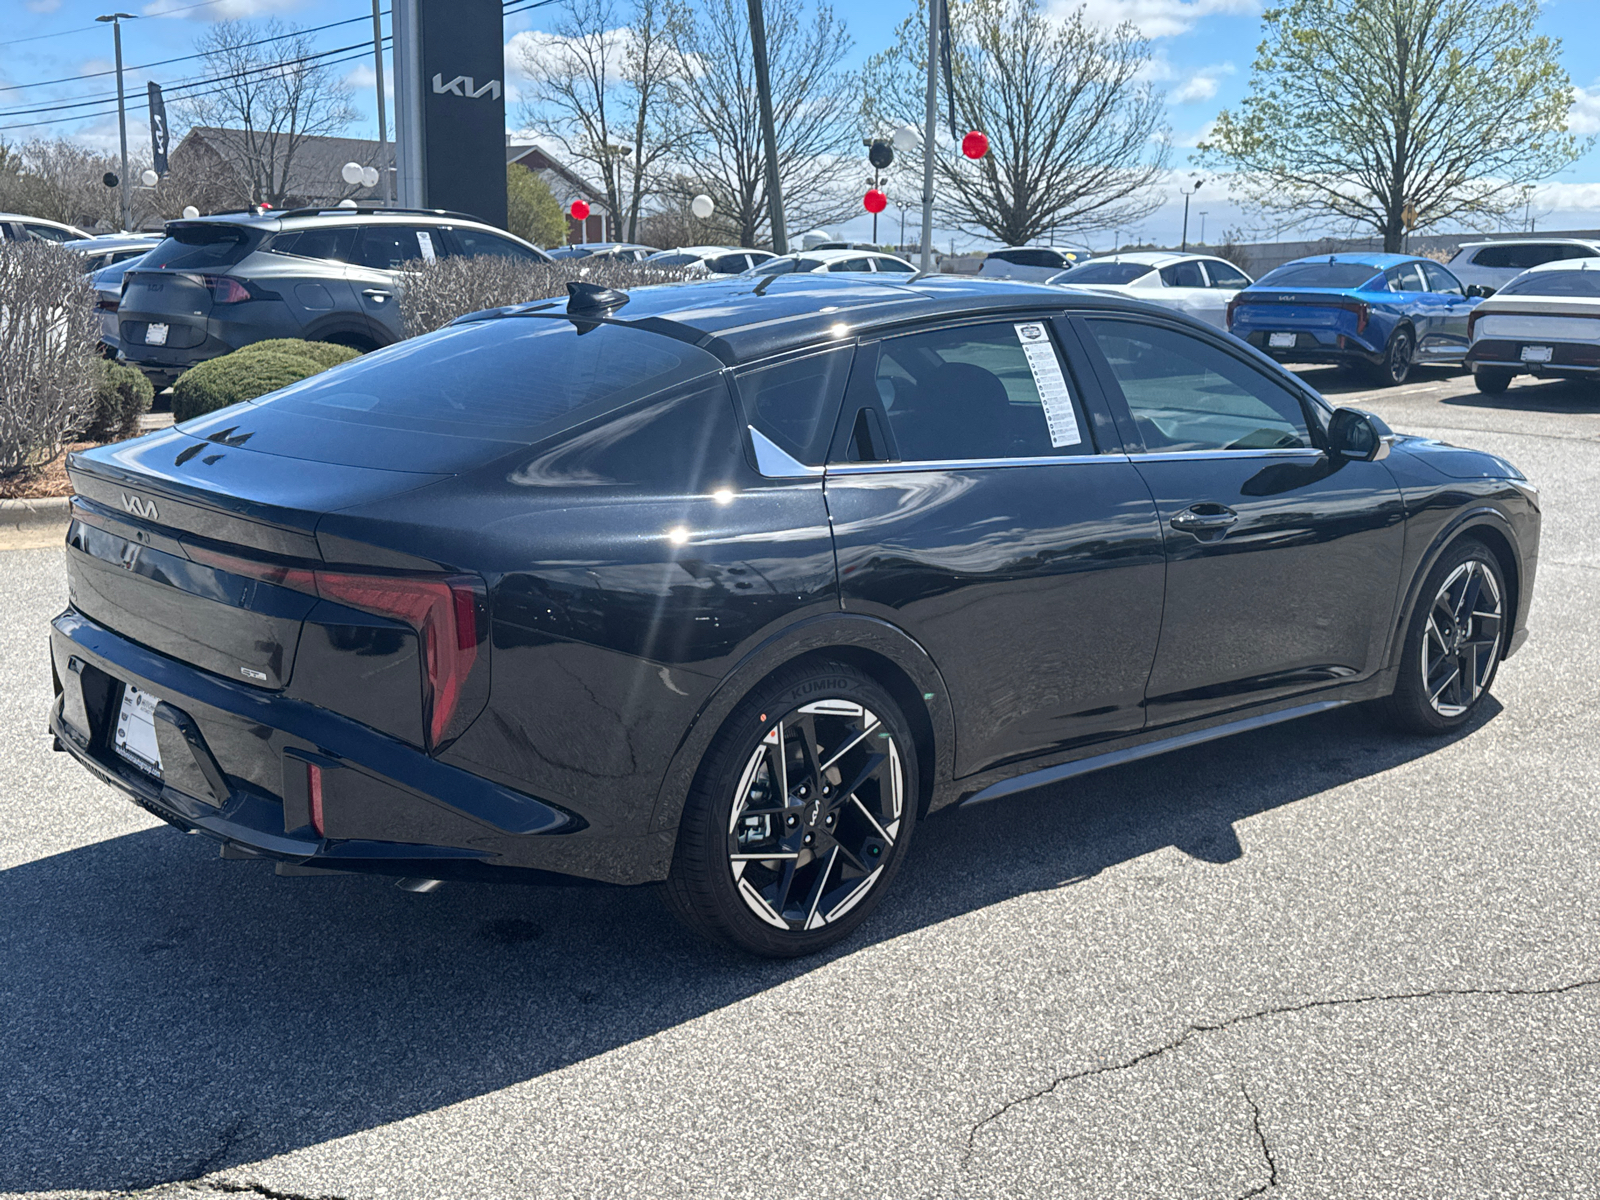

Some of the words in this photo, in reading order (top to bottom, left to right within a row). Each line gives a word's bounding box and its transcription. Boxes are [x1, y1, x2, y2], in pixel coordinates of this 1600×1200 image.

[432, 73, 501, 101] KIA
[121, 491, 159, 520] KIA
[791, 679, 848, 700] KUMHO
